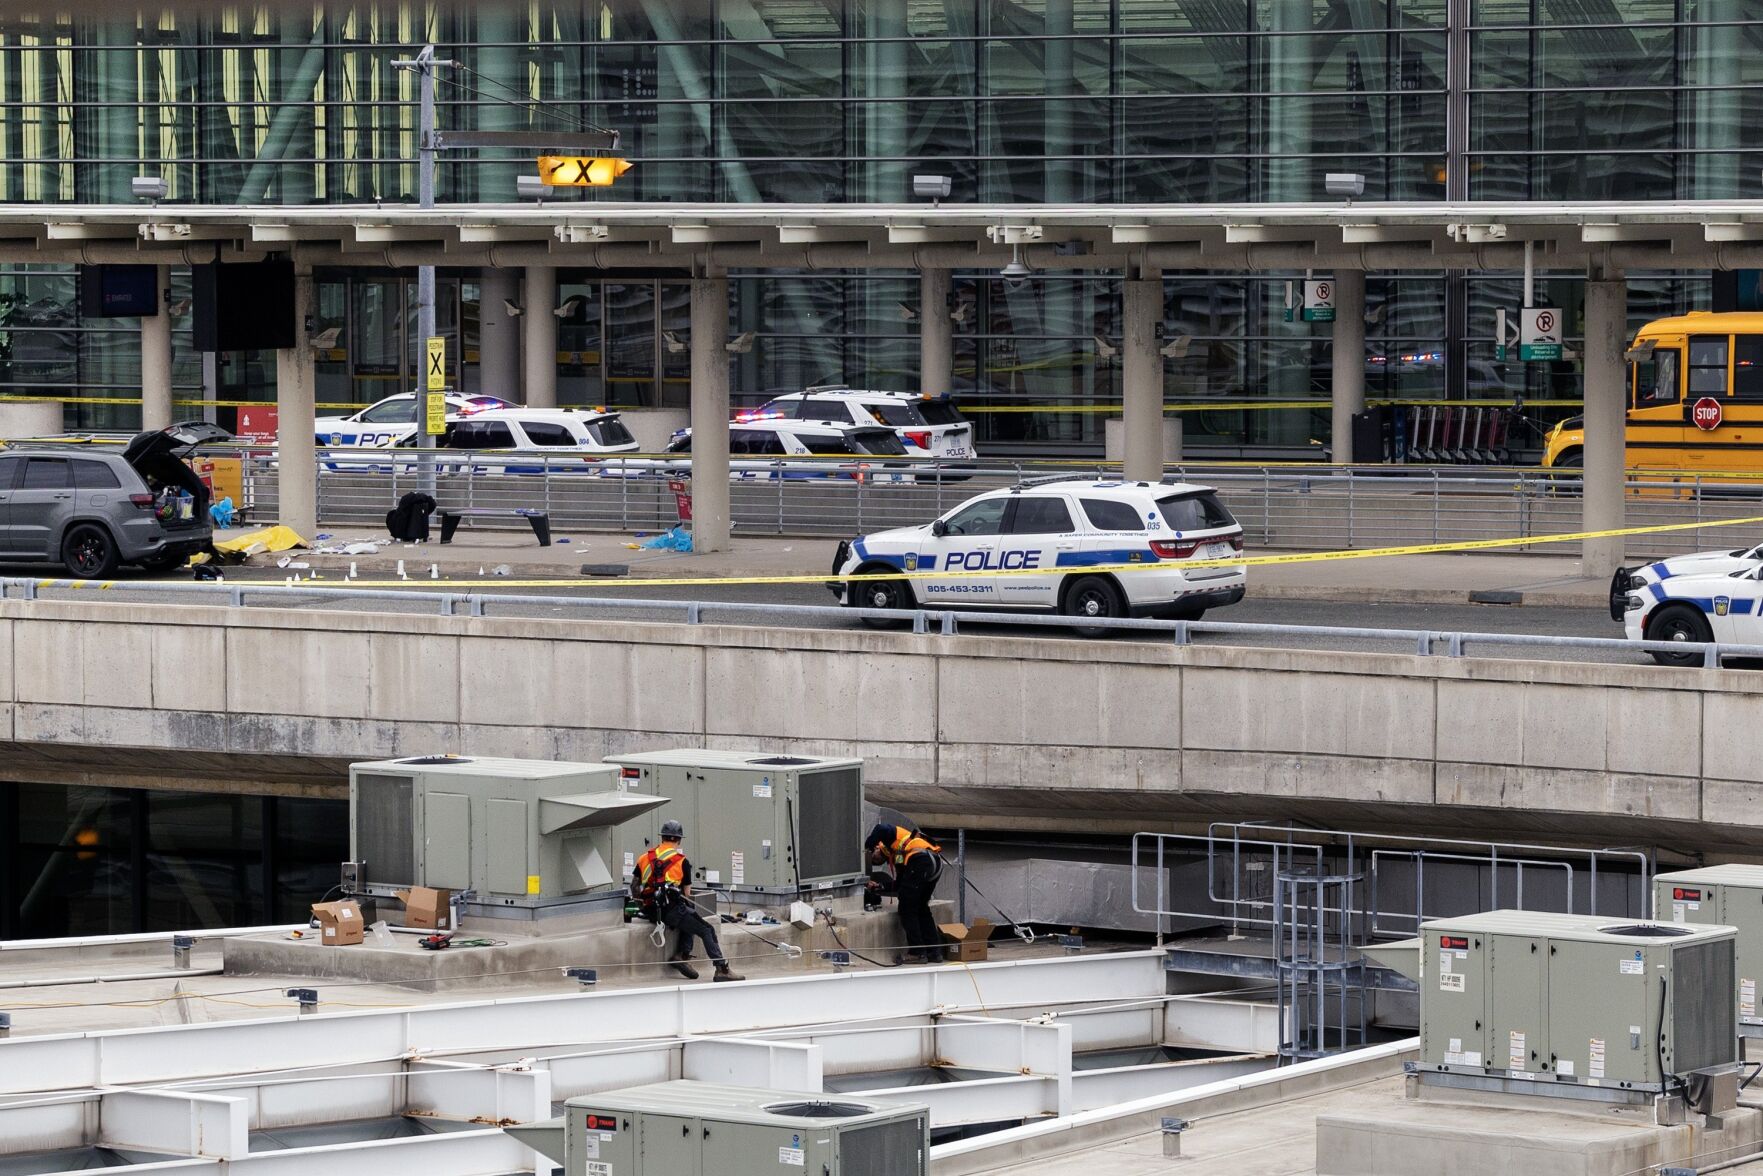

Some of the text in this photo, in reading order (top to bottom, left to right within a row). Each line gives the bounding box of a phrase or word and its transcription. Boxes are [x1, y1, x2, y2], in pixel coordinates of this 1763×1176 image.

[573, 160, 595, 183] X
[430, 352, 442, 375] X
[1696, 407, 1718, 420] STOP
[946, 447, 966, 456] POLICE
[1147, 521, 1161, 531] 035
[944, 550, 1042, 571] POLICE
[927, 585, 993, 593] 905-453-3311
